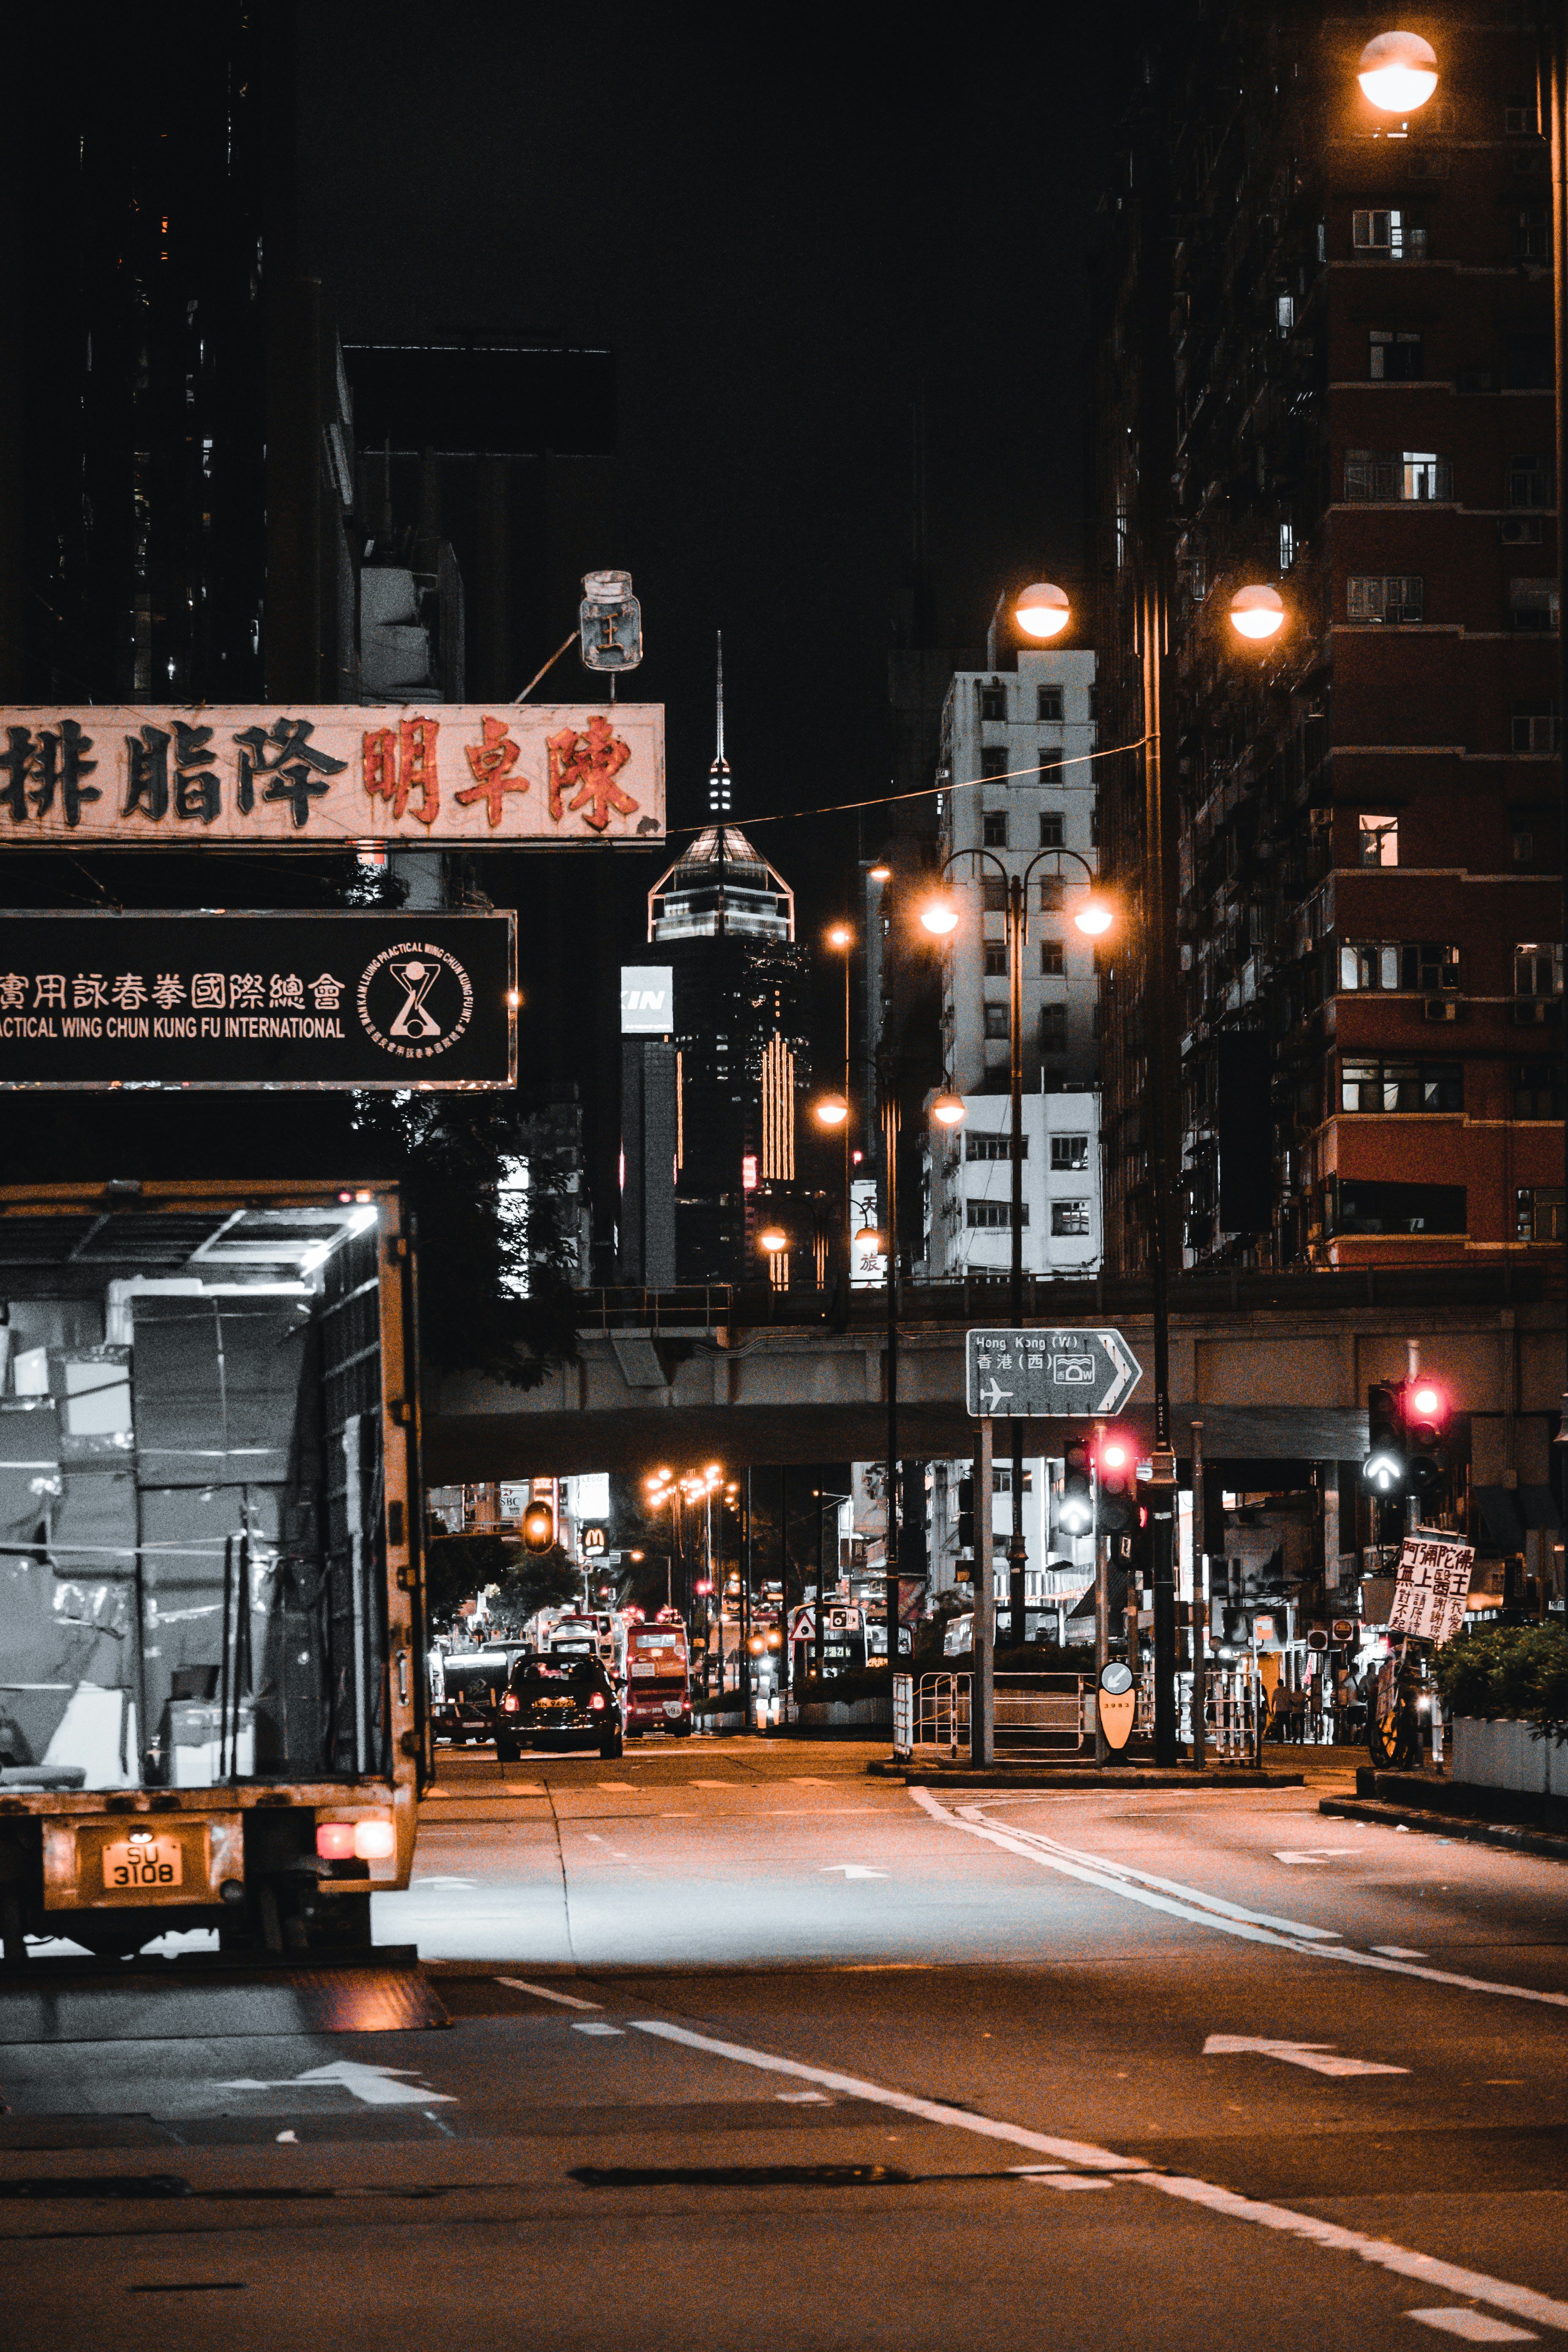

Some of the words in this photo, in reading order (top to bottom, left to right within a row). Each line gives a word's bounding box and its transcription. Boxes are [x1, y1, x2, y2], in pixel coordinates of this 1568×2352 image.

[377, 942, 423, 964] PRACTICAL
[424, 943, 444, 958] WING
[359, 958, 381, 986] LEUNG
[443, 953, 465, 975] CHUN
[457, 972, 473, 996] KUNG
[357, 985, 368, 1006] KAM
[463, 996, 474, 1008] FU
[61, 1017, 103, 1038] WING
[106, 1017, 149, 1038] CHUN
[153, 1017, 197, 1038] KUNG
[201, 1017, 220, 1038] FU
[225, 1017, 346, 1038] INTERNATIONAL
[976, 1337, 1006, 1351] Hong
[1015, 1337, 1046, 1350] Kong
[1051, 1336, 1078, 1348] (W)
[977, 1353, 1052, 1369] 香港(西)
[1082, 1371, 1093, 1380] W
[1400, 1541, 1473, 1573] 阿彌陀佛
[127, 1847, 159, 1865] SU
[114, 1864, 173, 1885] 3108
